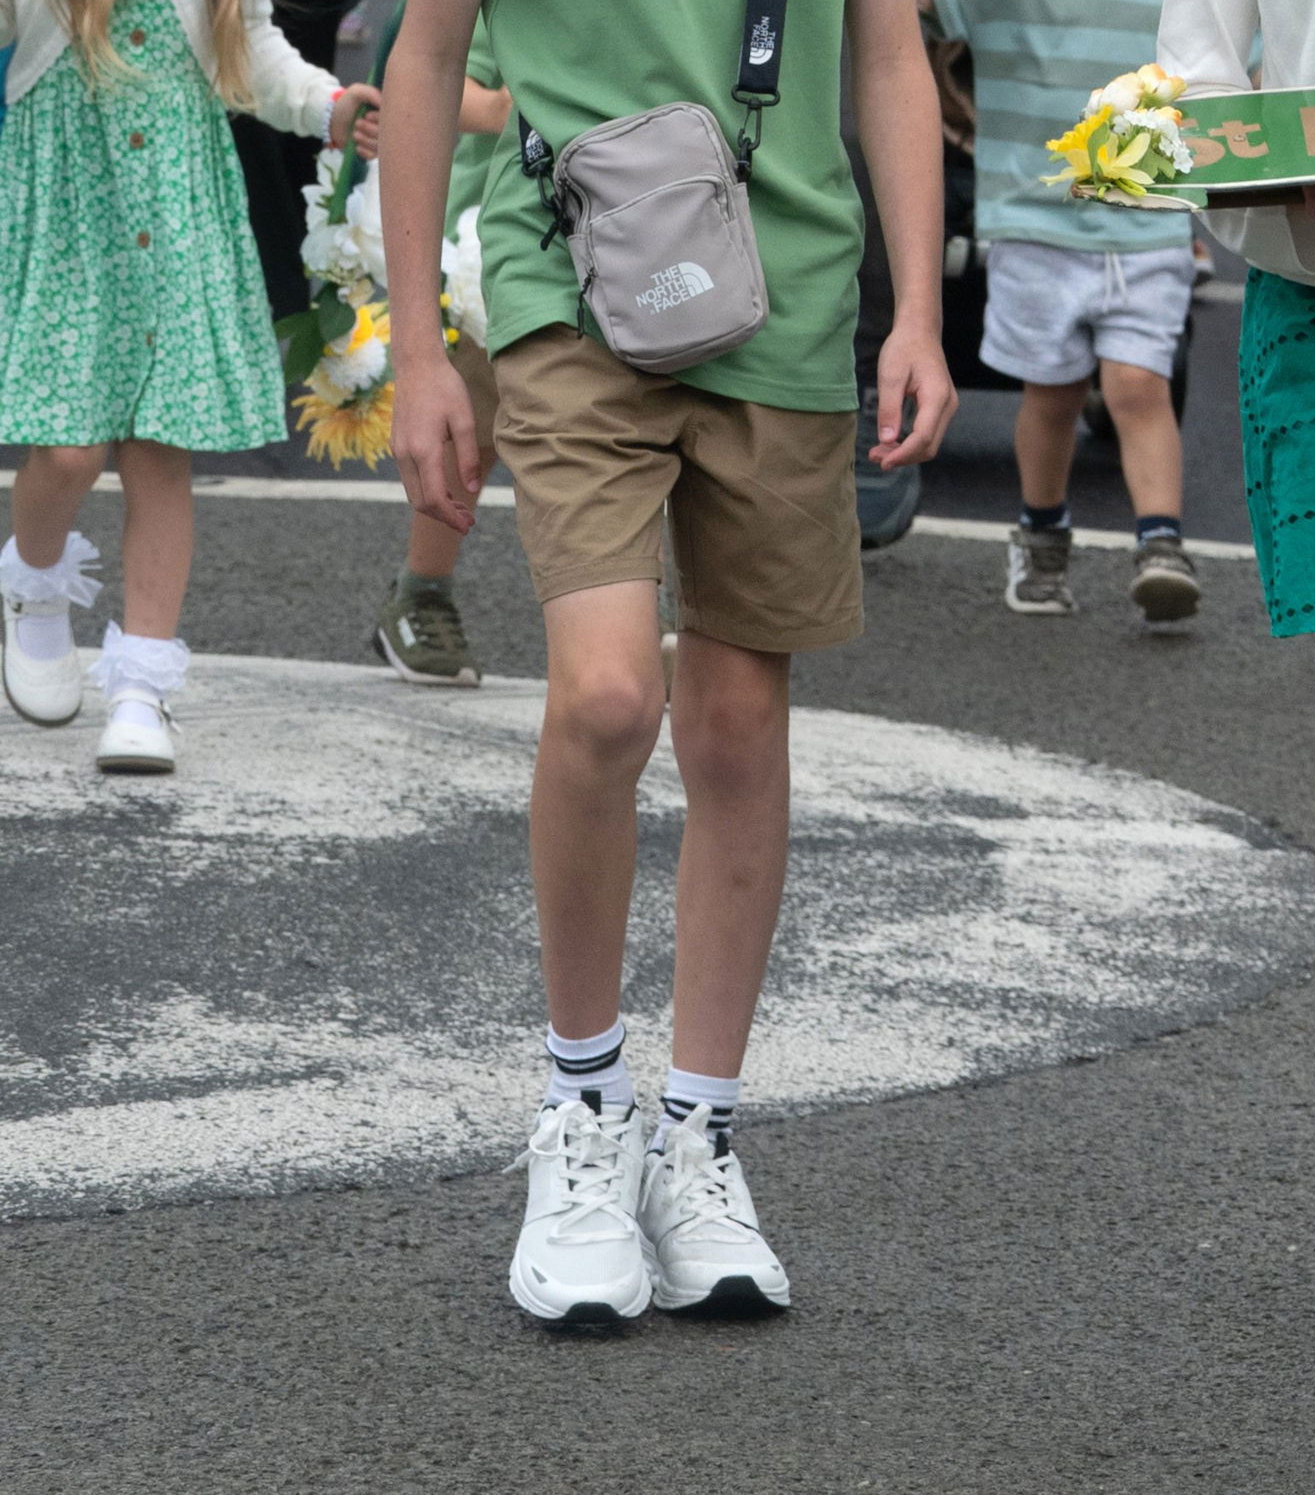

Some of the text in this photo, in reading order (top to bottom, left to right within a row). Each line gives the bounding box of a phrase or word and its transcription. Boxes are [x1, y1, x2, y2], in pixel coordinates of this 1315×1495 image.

[750, 24, 761, 48] FACE
[758, 15, 770, 49] NORTH
[766, 31, 776, 49] THE
[650, 265, 681, 286] THE
[635, 276, 687, 308] NORTH
[653, 288, 692, 314] FACE
